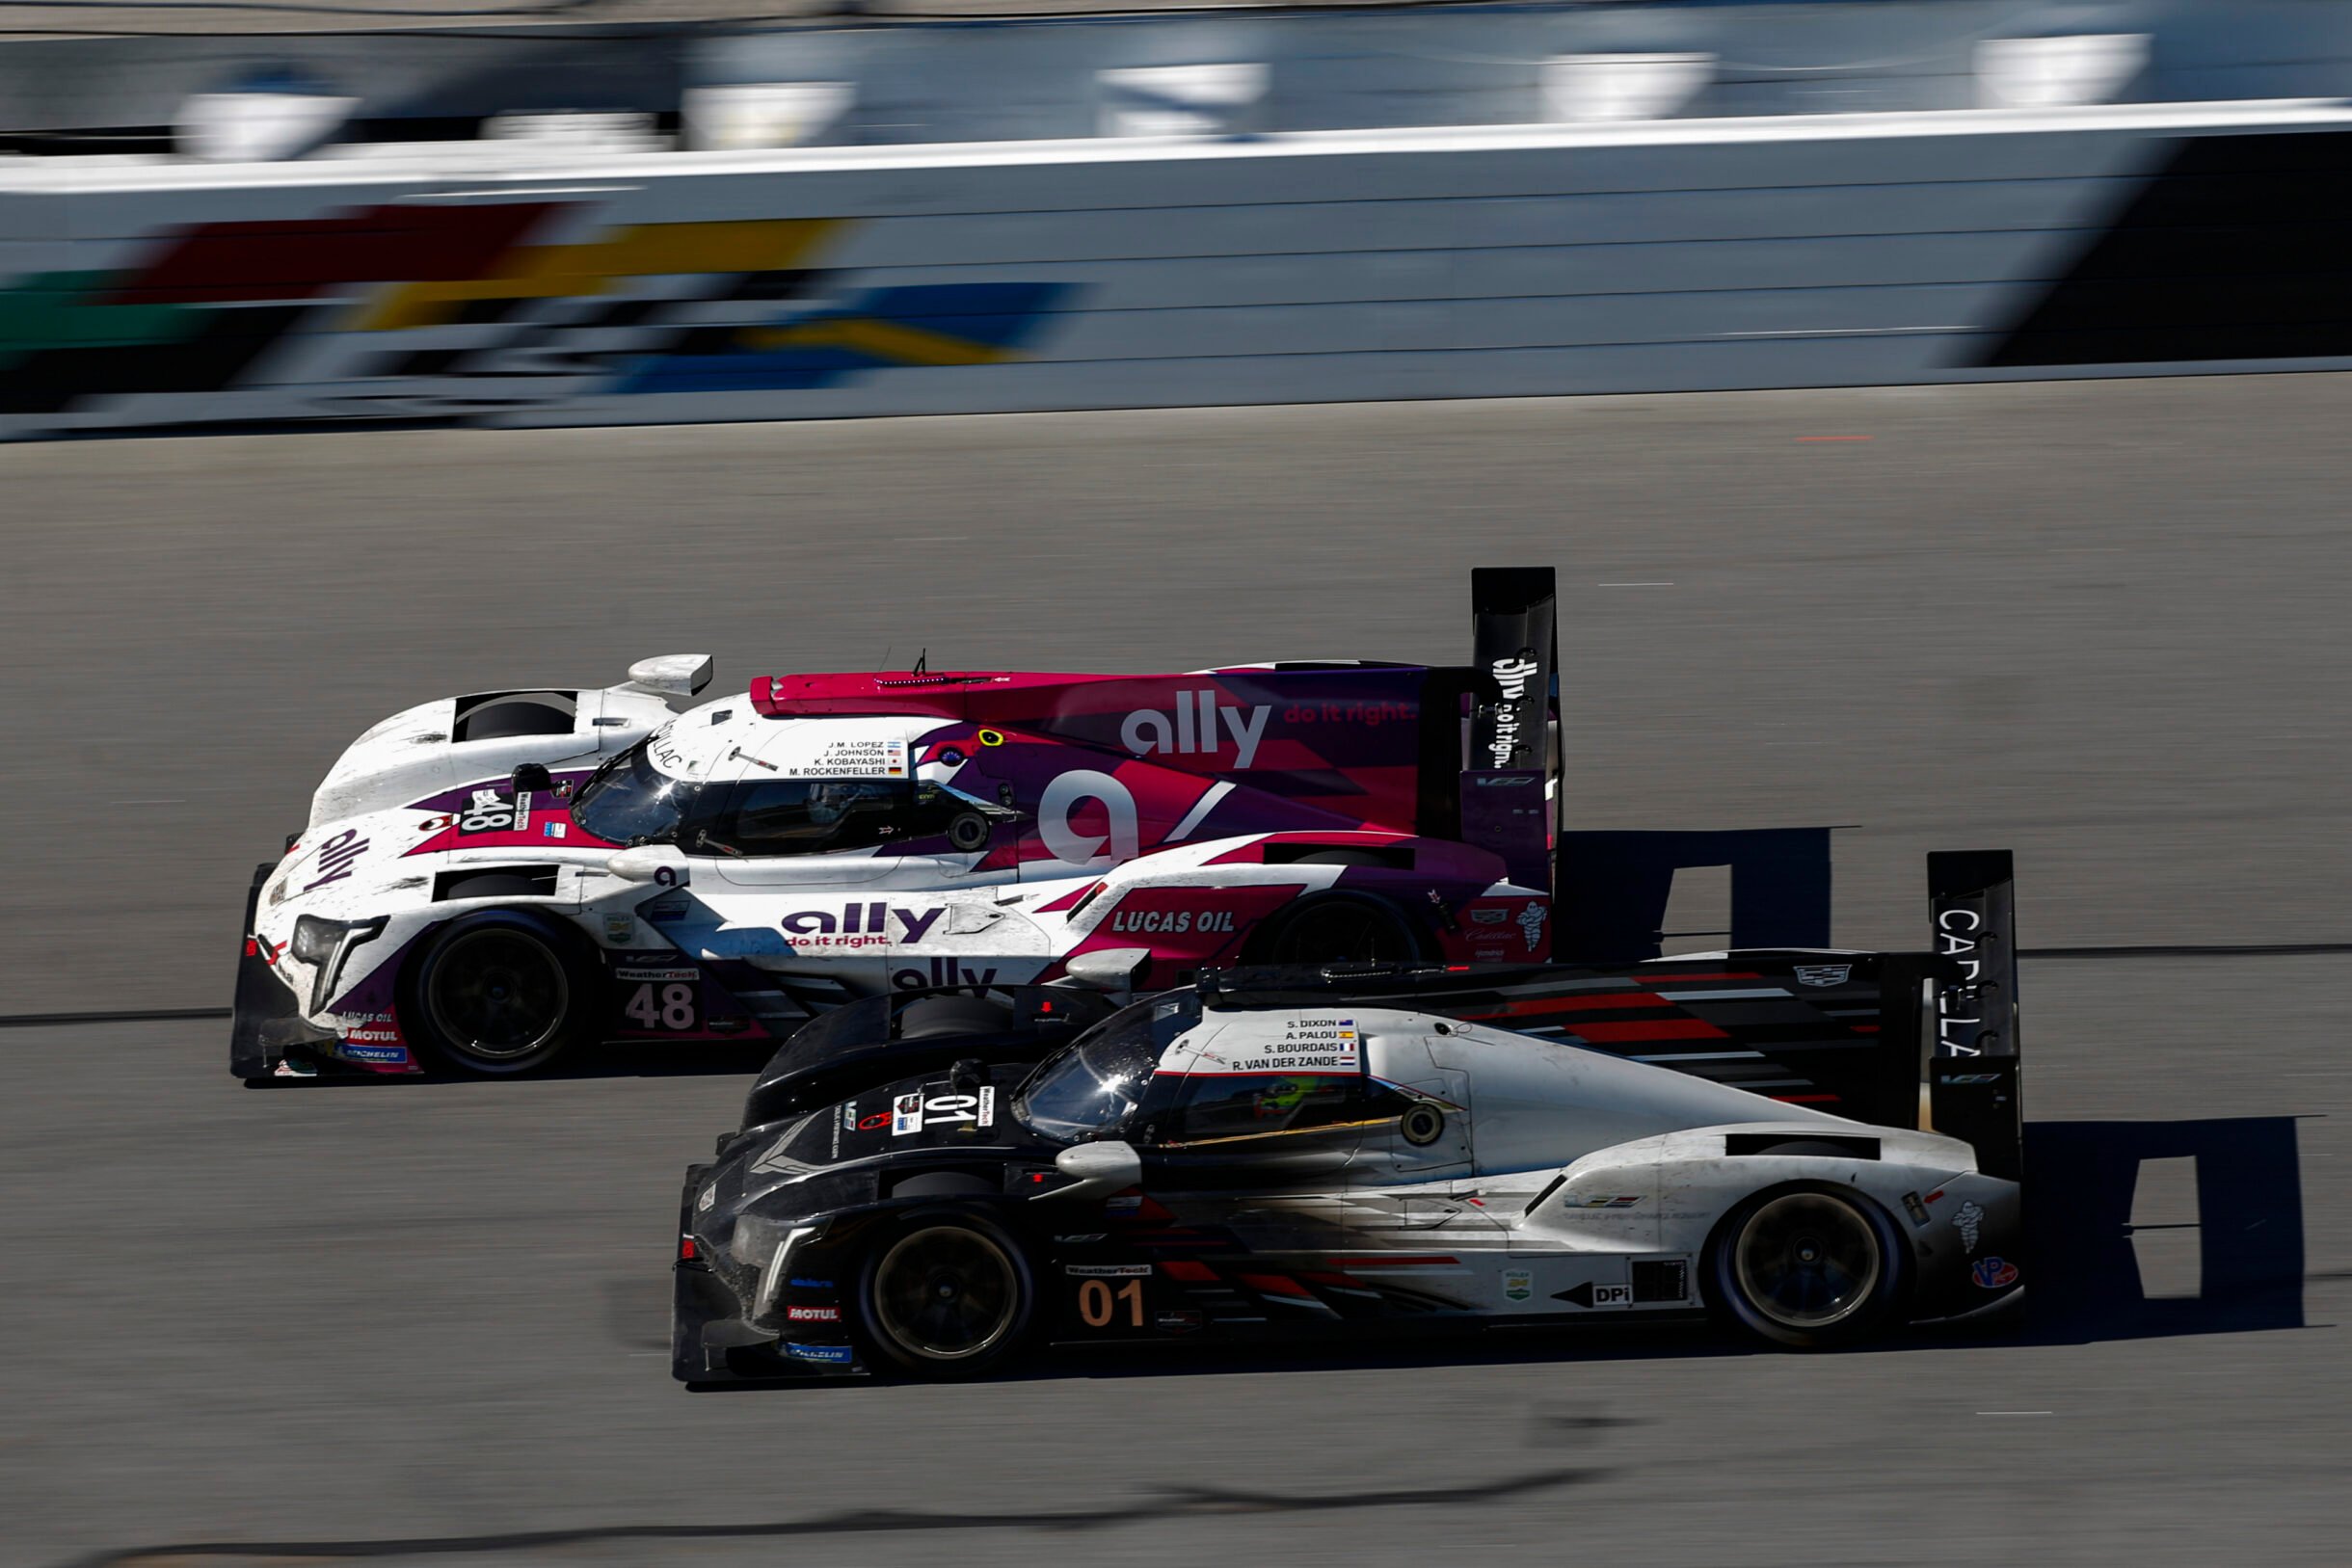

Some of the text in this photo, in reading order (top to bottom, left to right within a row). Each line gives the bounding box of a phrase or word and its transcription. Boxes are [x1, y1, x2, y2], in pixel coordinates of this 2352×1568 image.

[1283, 700, 1418, 727] do it right.
[1120, 690, 1272, 769] ally
[827, 757, 886, 766] KOBAYASHI
[789, 766, 886, 776] M. ROCKENFELLER
[461, 797, 514, 832] 48
[304, 829, 369, 891] ally
[782, 902, 948, 944] ally
[1111, 911, 1235, 933] LUCAS OIL
[786, 935, 893, 949] do it right.
[618, 970, 696, 979] WeatherTech
[625, 982, 695, 1031] 48
[376, 1013, 393, 1023] OIL
[1287, 1019, 1337, 1028] S. DIXON
[349, 1029, 398, 1042] MOTUL
[1286, 1030, 1338, 1040] A. PALOU
[1264, 1042, 1338, 1053] S. BOURDAIS
[1233, 1055, 1339, 1071] R. VAN DER ZANDE
[924, 1094, 978, 1125] 01
[980, 1088, 992, 1125] WeatherTech
[1068, 1265, 1149, 1274] WeatherTech
[1079, 1278, 1144, 1327] 01
[1595, 1287, 1630, 1303] DPi
[789, 1308, 839, 1319] MOTUL
